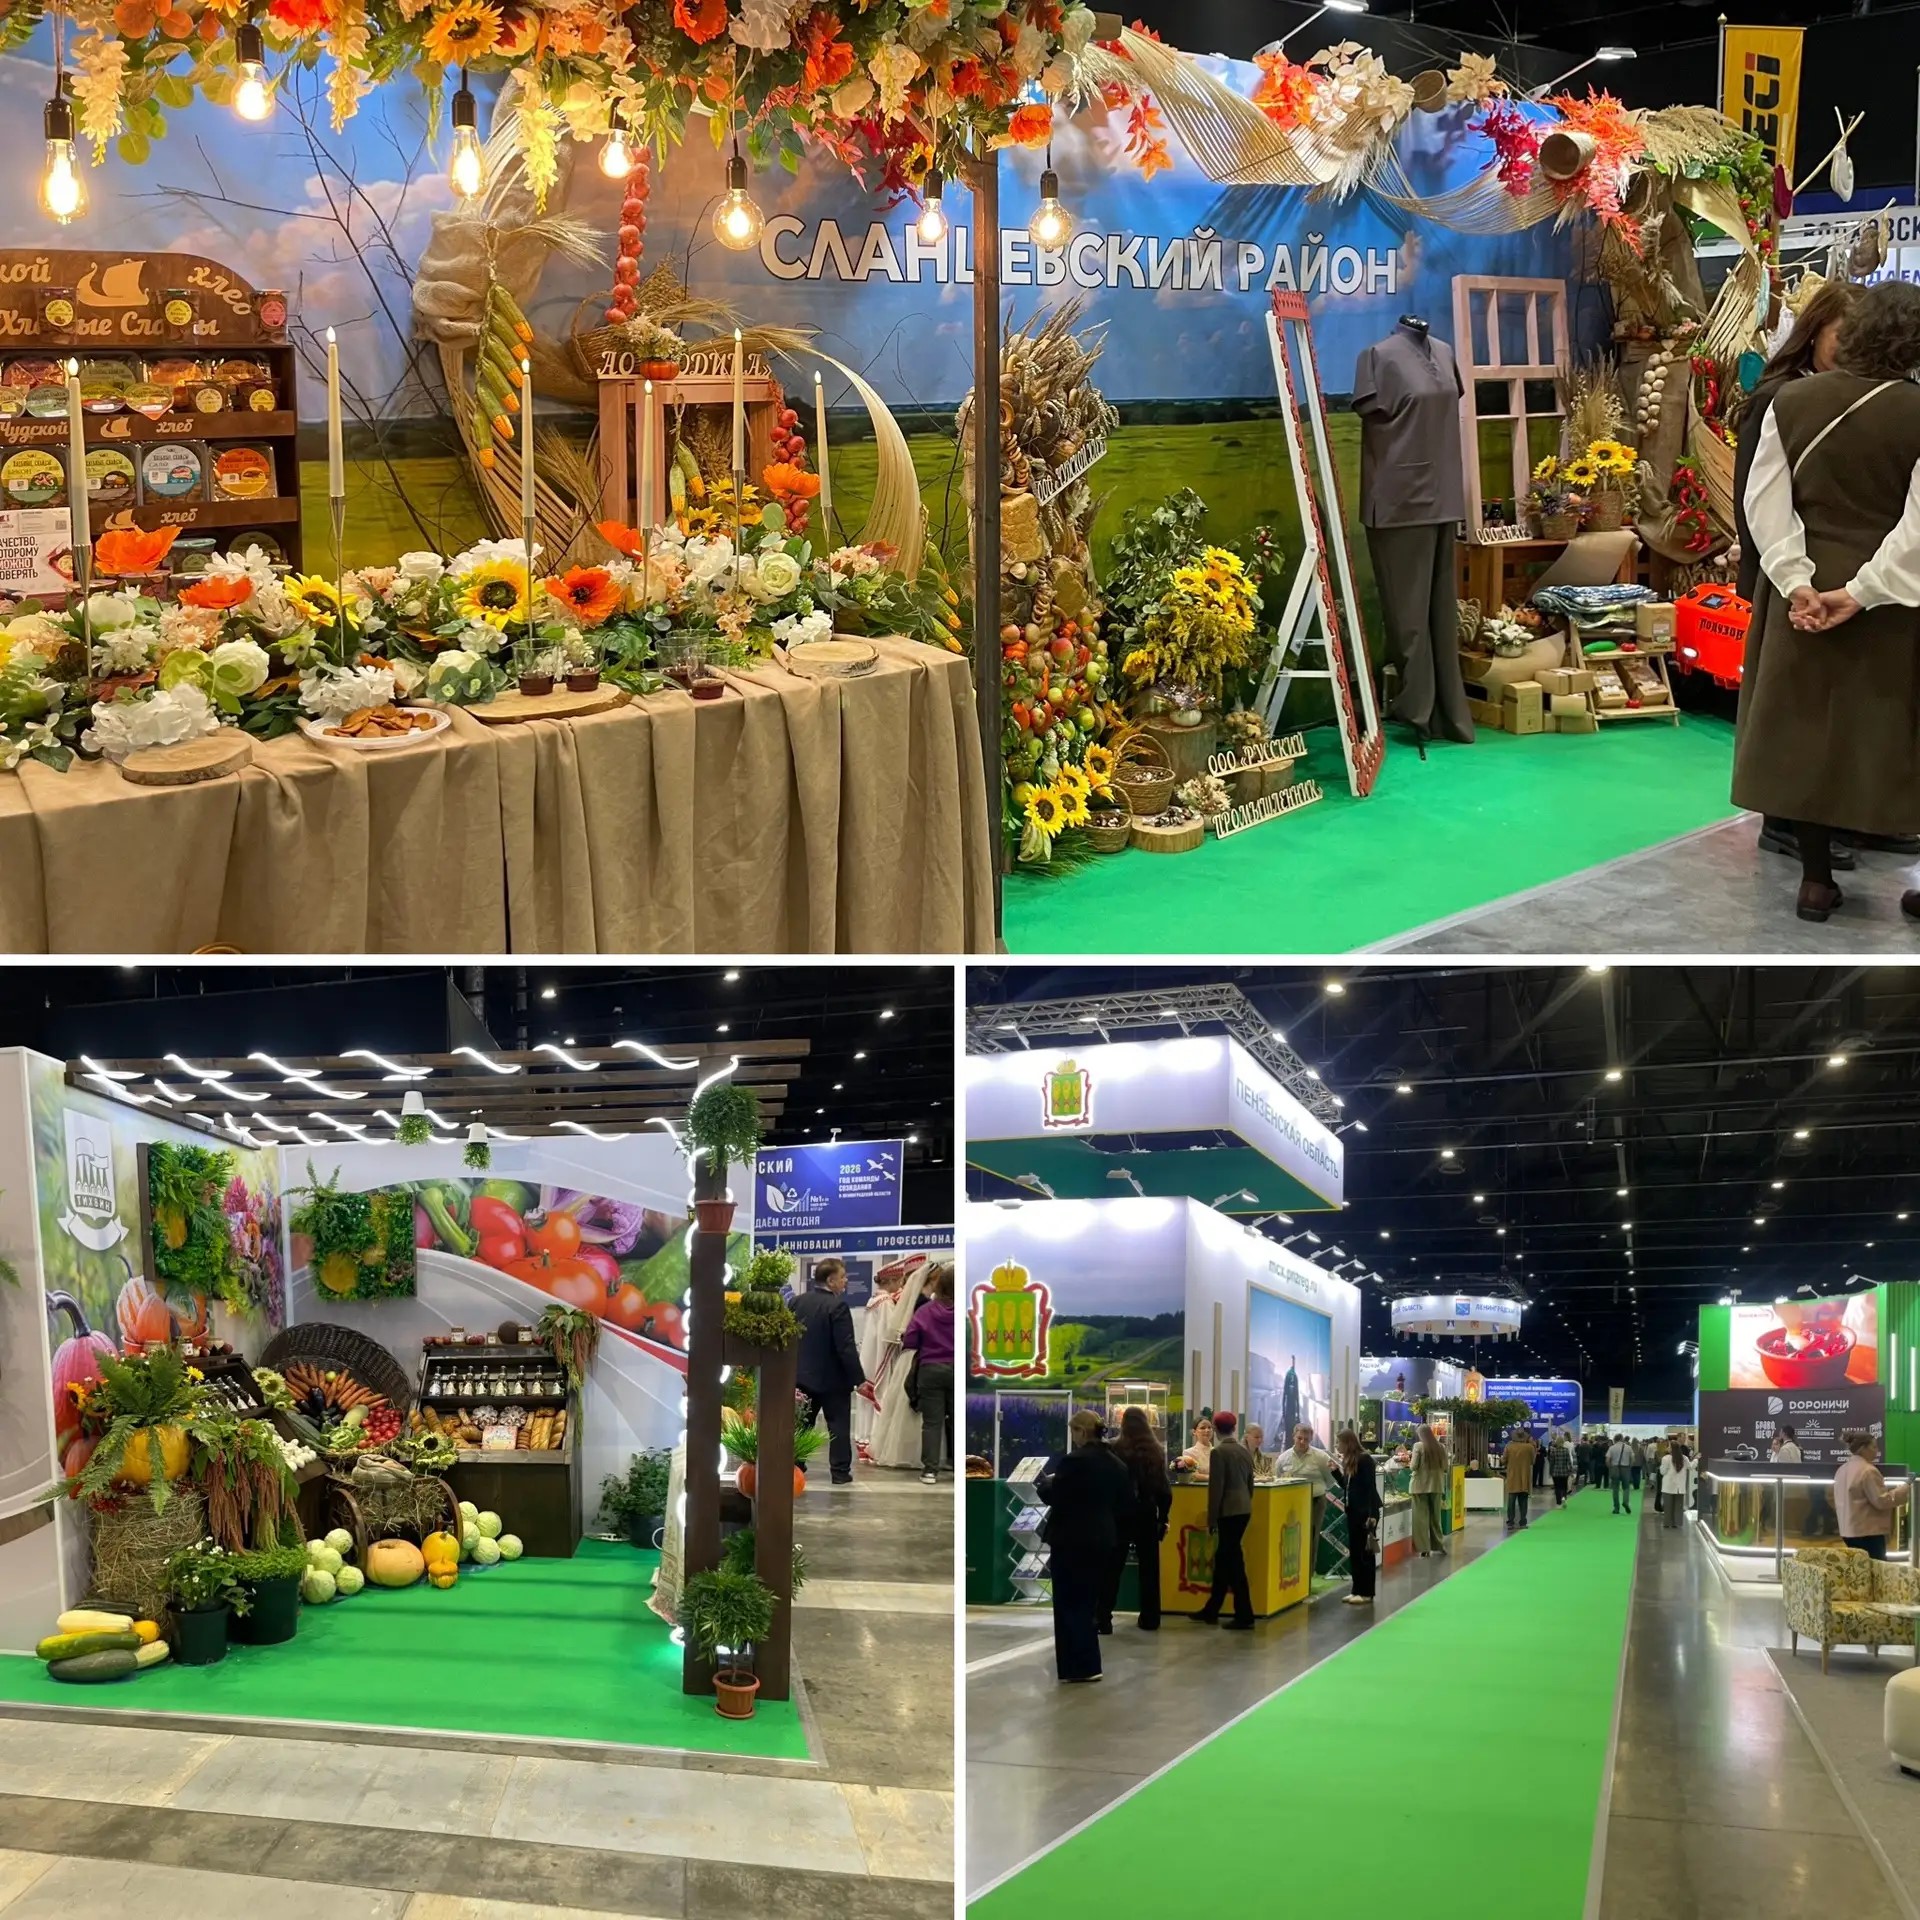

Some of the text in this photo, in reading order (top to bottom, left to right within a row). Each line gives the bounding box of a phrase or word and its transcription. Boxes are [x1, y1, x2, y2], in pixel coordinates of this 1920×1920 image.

[1238, 231, 1398, 295] РАЙОН
[597, 351, 635, 375] АО
[0, 418, 193, 444] Чудской хлеб
[160, 508, 198, 524] хлеб
[1207, 731, 1308, 774] ООО «РУССКИЙ
[1211, 779, 1324, 838] ПРОМЫШЛЕННИК»
[1236, 1077, 1340, 1179] ПЕНЗЕНСКАЯ ОБЛАСТЬ
[839, 1163, 862, 1175] 2026
[781, 1215, 820, 1227] СЕГОДНЯ
[783, 1239, 842, 1250] ИННОВАЦИИ
